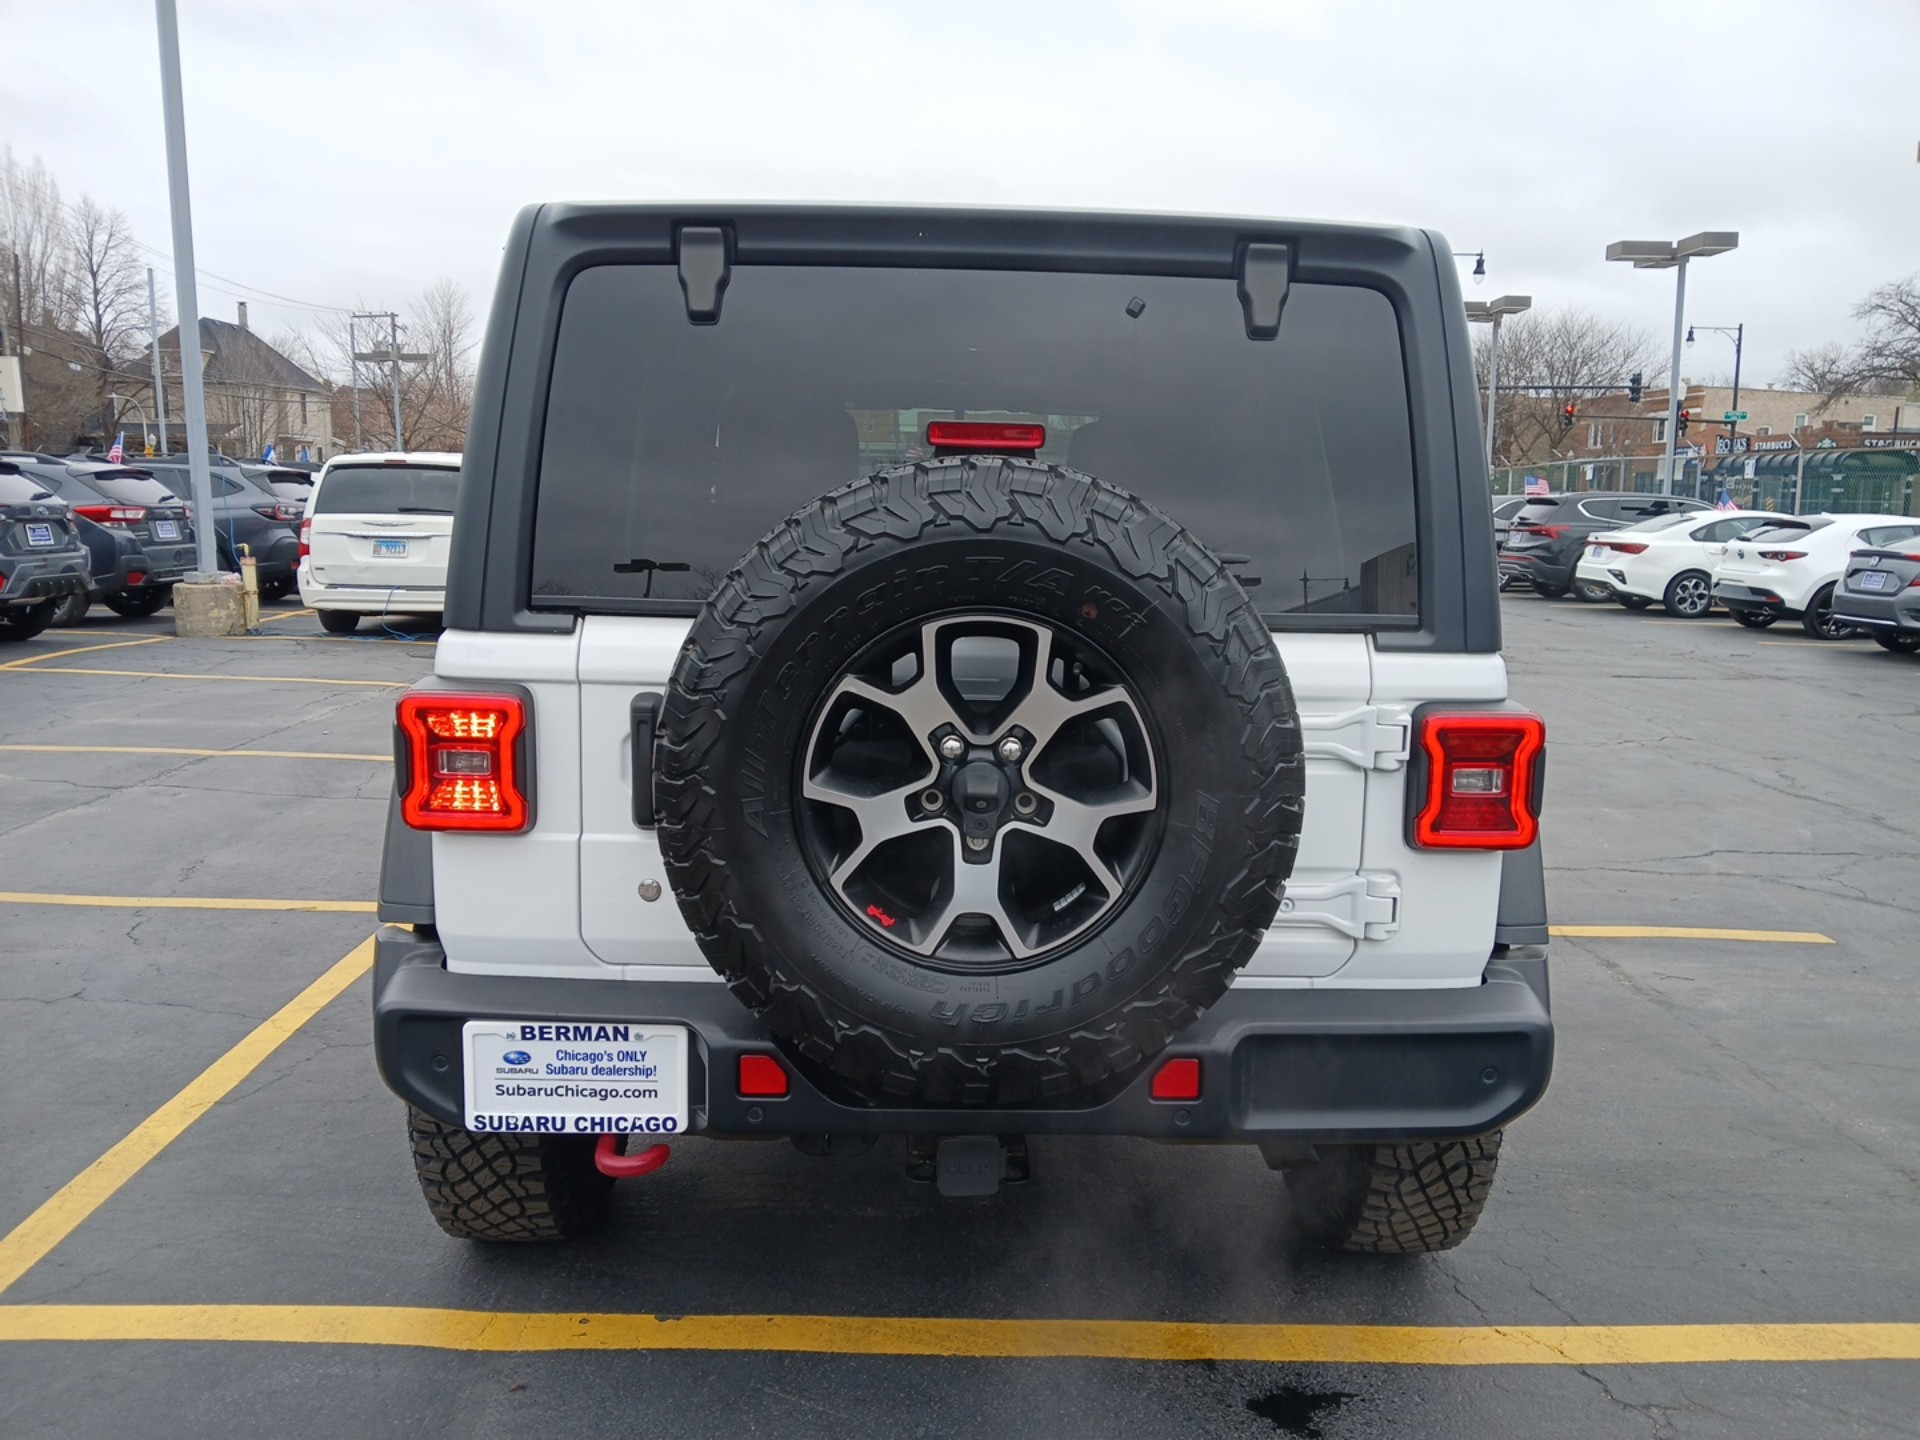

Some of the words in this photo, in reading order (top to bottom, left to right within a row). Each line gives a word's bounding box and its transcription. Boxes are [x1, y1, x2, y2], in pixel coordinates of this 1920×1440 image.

[1755, 441, 1792, 451] STARBUCKS
[965, 555, 1075, 592] T/A
[928, 789, 1219, 1028] BFGoodrich
[520, 1025, 629, 1041] BERMAN
[556, 1050, 613, 1064] Chicago's
[617, 1051, 647, 1062] ONLY
[546, 1064, 587, 1076] Subaru
[591, 1064, 657, 1078] dealership!
[495, 1084, 658, 1100] SubaruChicago.com
[474, 1115, 566, 1132] SUBARU
[574, 1117, 678, 1132] CHICAGO
